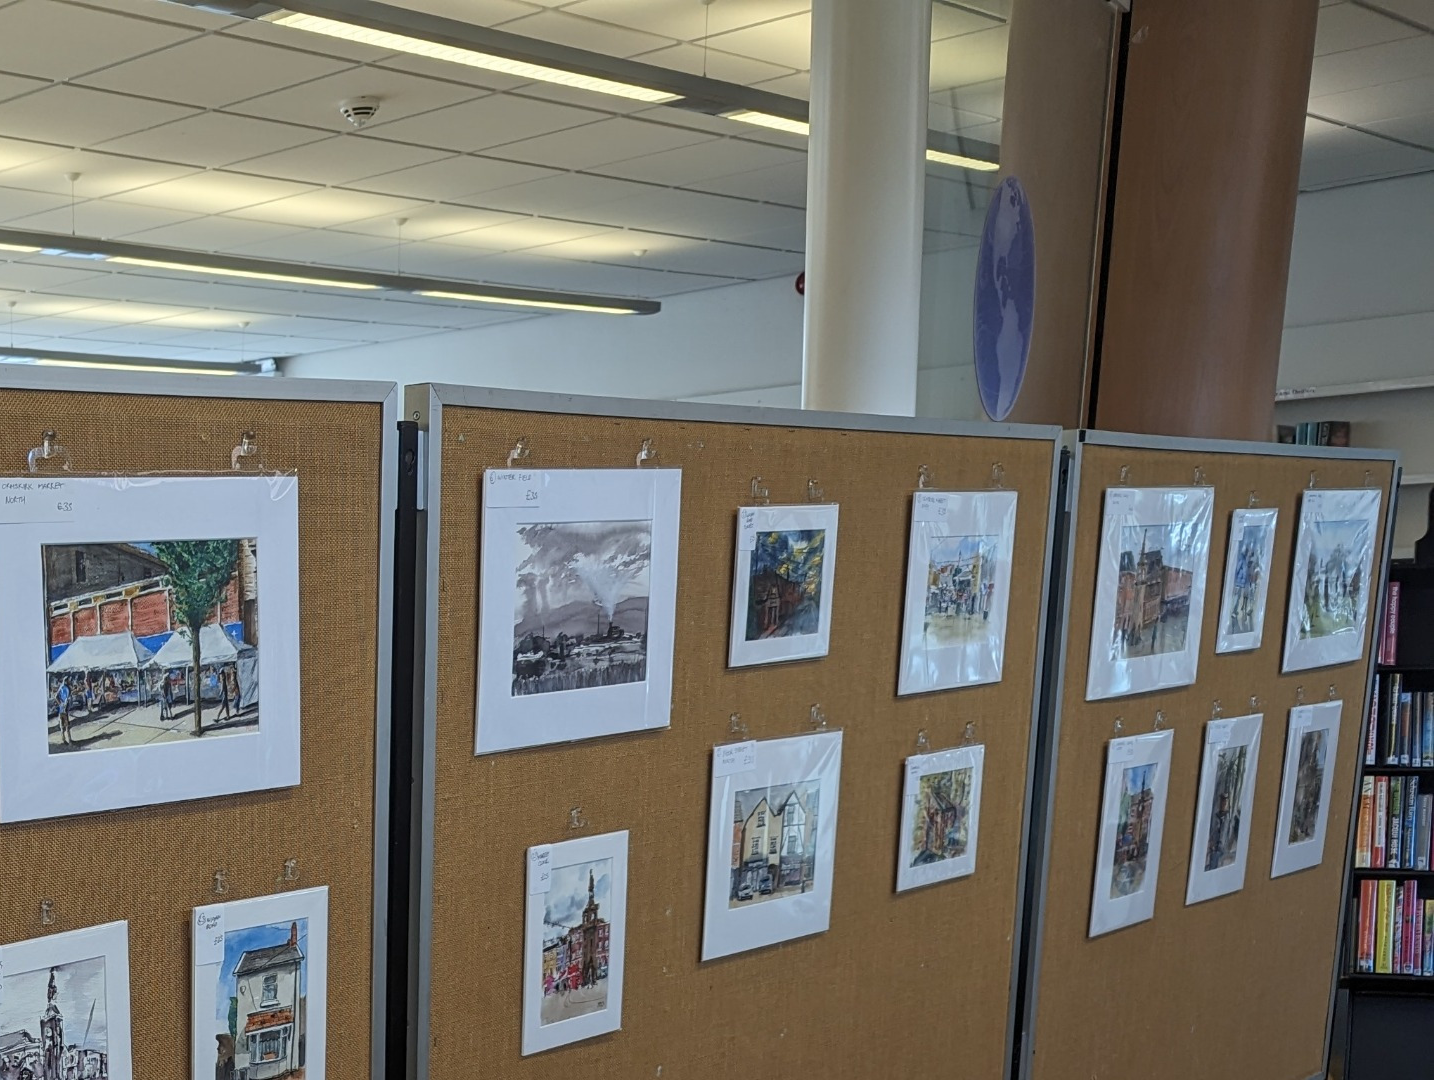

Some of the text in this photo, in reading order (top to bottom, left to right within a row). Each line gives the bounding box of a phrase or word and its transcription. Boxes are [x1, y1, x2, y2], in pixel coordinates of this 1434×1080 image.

[38, 482, 65, 490] MARKET
[5, 496, 26, 505] NORTH
[1390, 597, 1398, 613] happy
